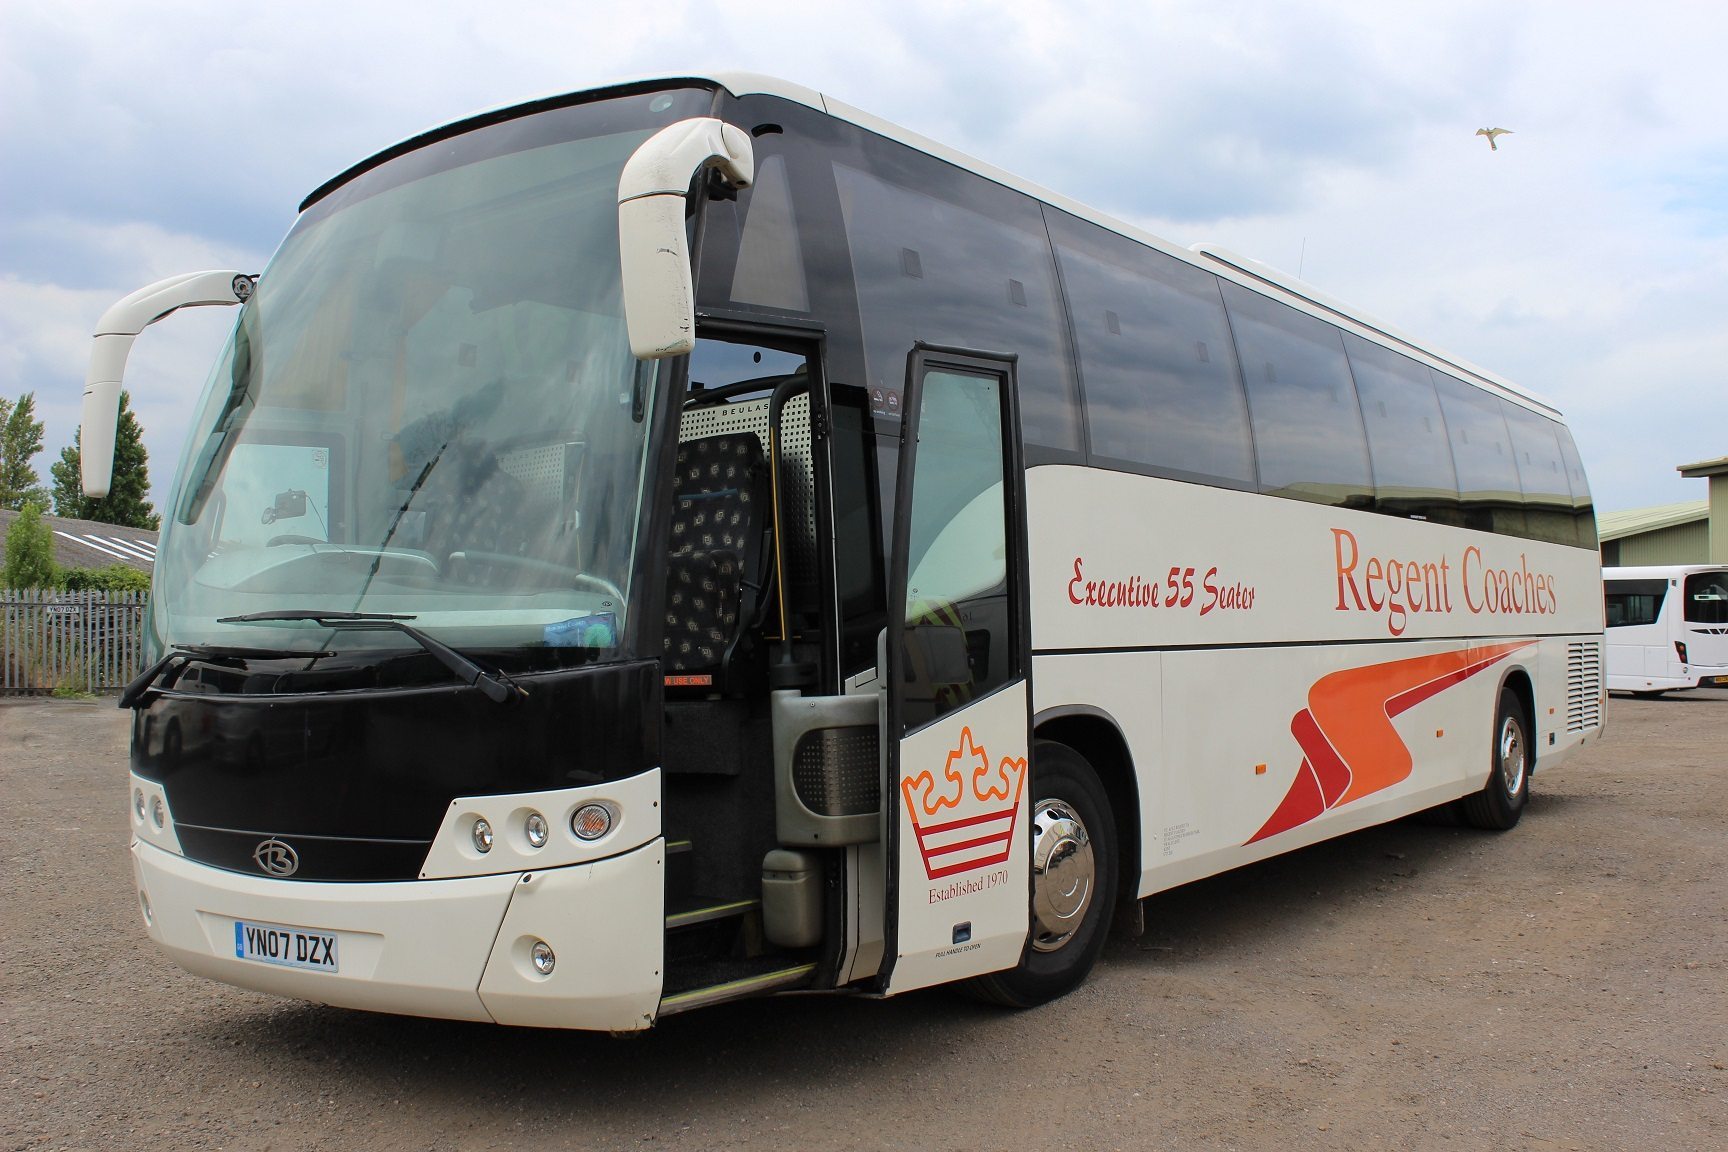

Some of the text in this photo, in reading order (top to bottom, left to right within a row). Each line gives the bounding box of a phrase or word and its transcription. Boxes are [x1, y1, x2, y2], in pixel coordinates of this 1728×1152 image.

[722, 404, 768, 416] BEULAS
[1068, 557, 1255, 617] Executive 55 Seater
[1330, 528, 1557, 636] Regent Coaches
[674, 677, 688, 685] USE
[689, 676, 709, 684] ONLY
[929, 870, 1008, 904] Established 1970
[246, 927, 335, 966] YN07 DZX
[946, 946, 963, 956] HANDLE
[969, 943, 981, 951] OPEN
